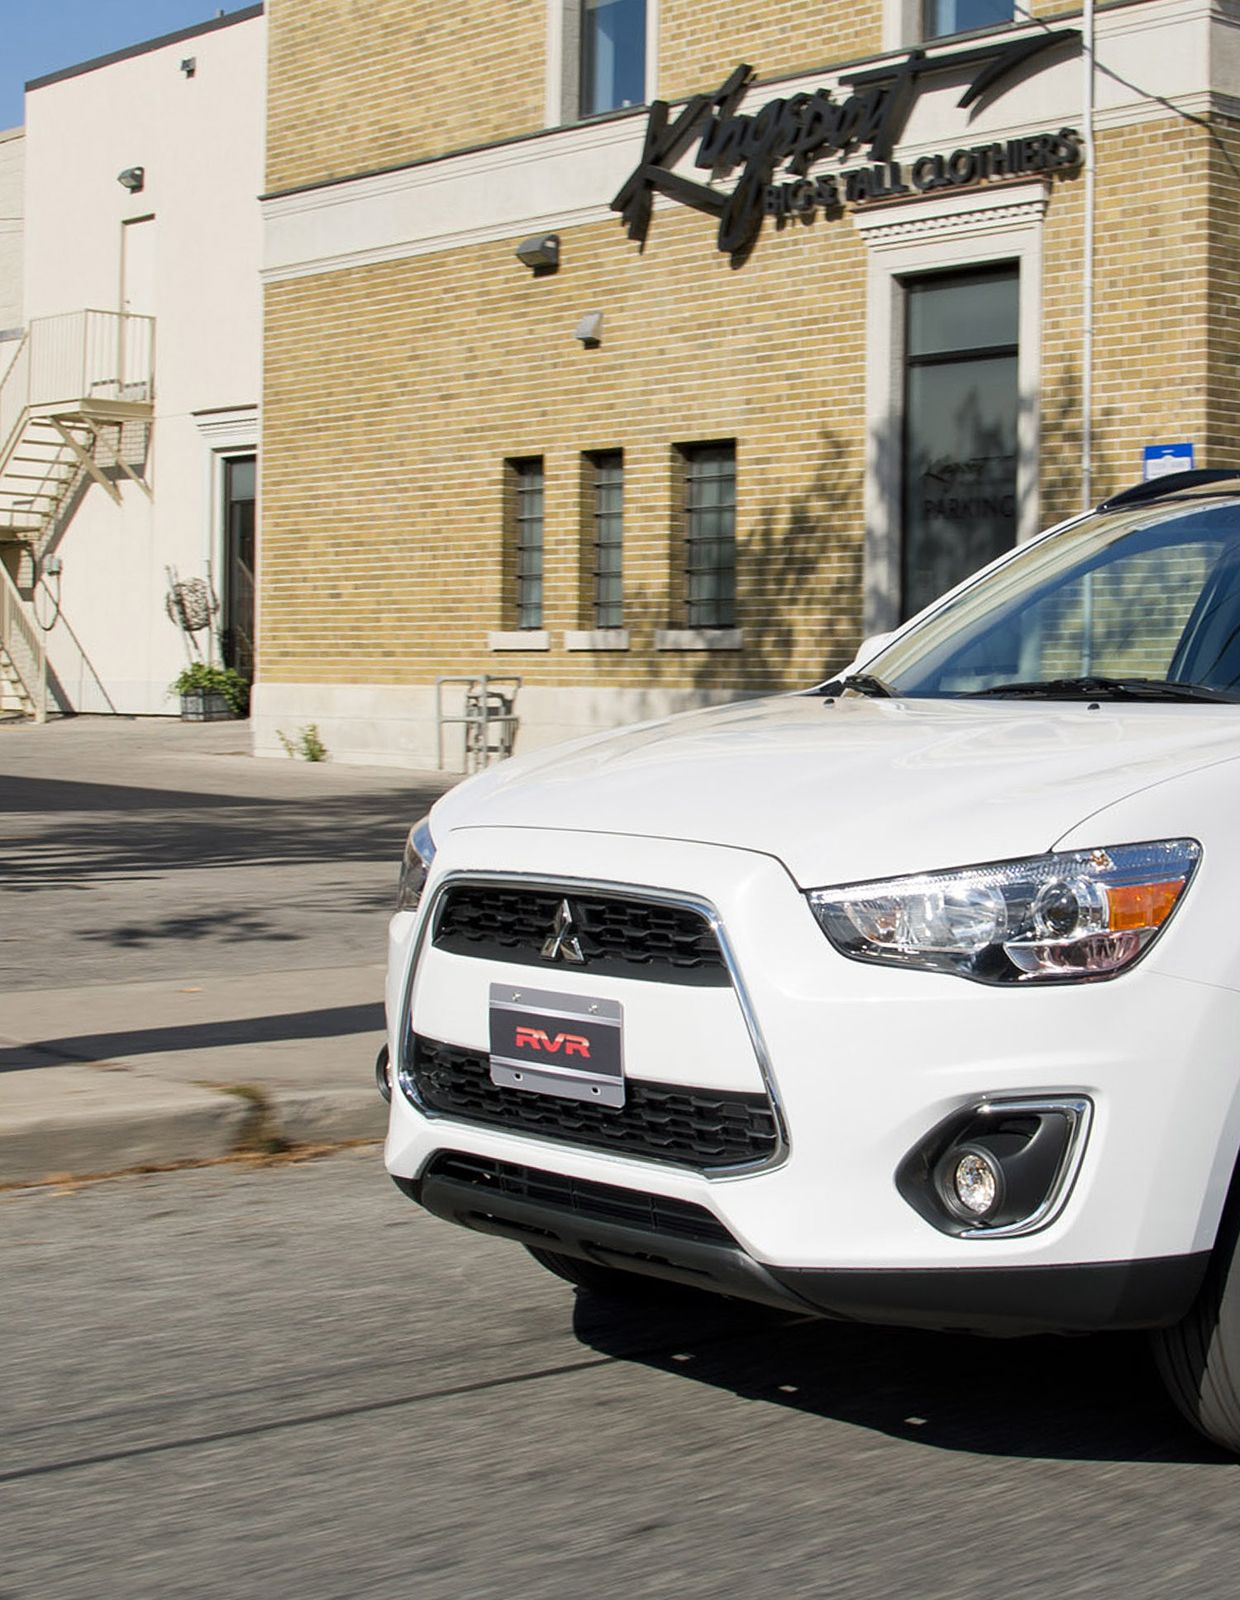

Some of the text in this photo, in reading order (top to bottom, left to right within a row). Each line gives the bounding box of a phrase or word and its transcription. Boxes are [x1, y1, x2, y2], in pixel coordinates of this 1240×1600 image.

[763, 127, 1080, 214] BIG & TALL CLOTHIERS
[923, 494, 1014, 521] PARKING
[515, 1026, 591, 1058] RVR
